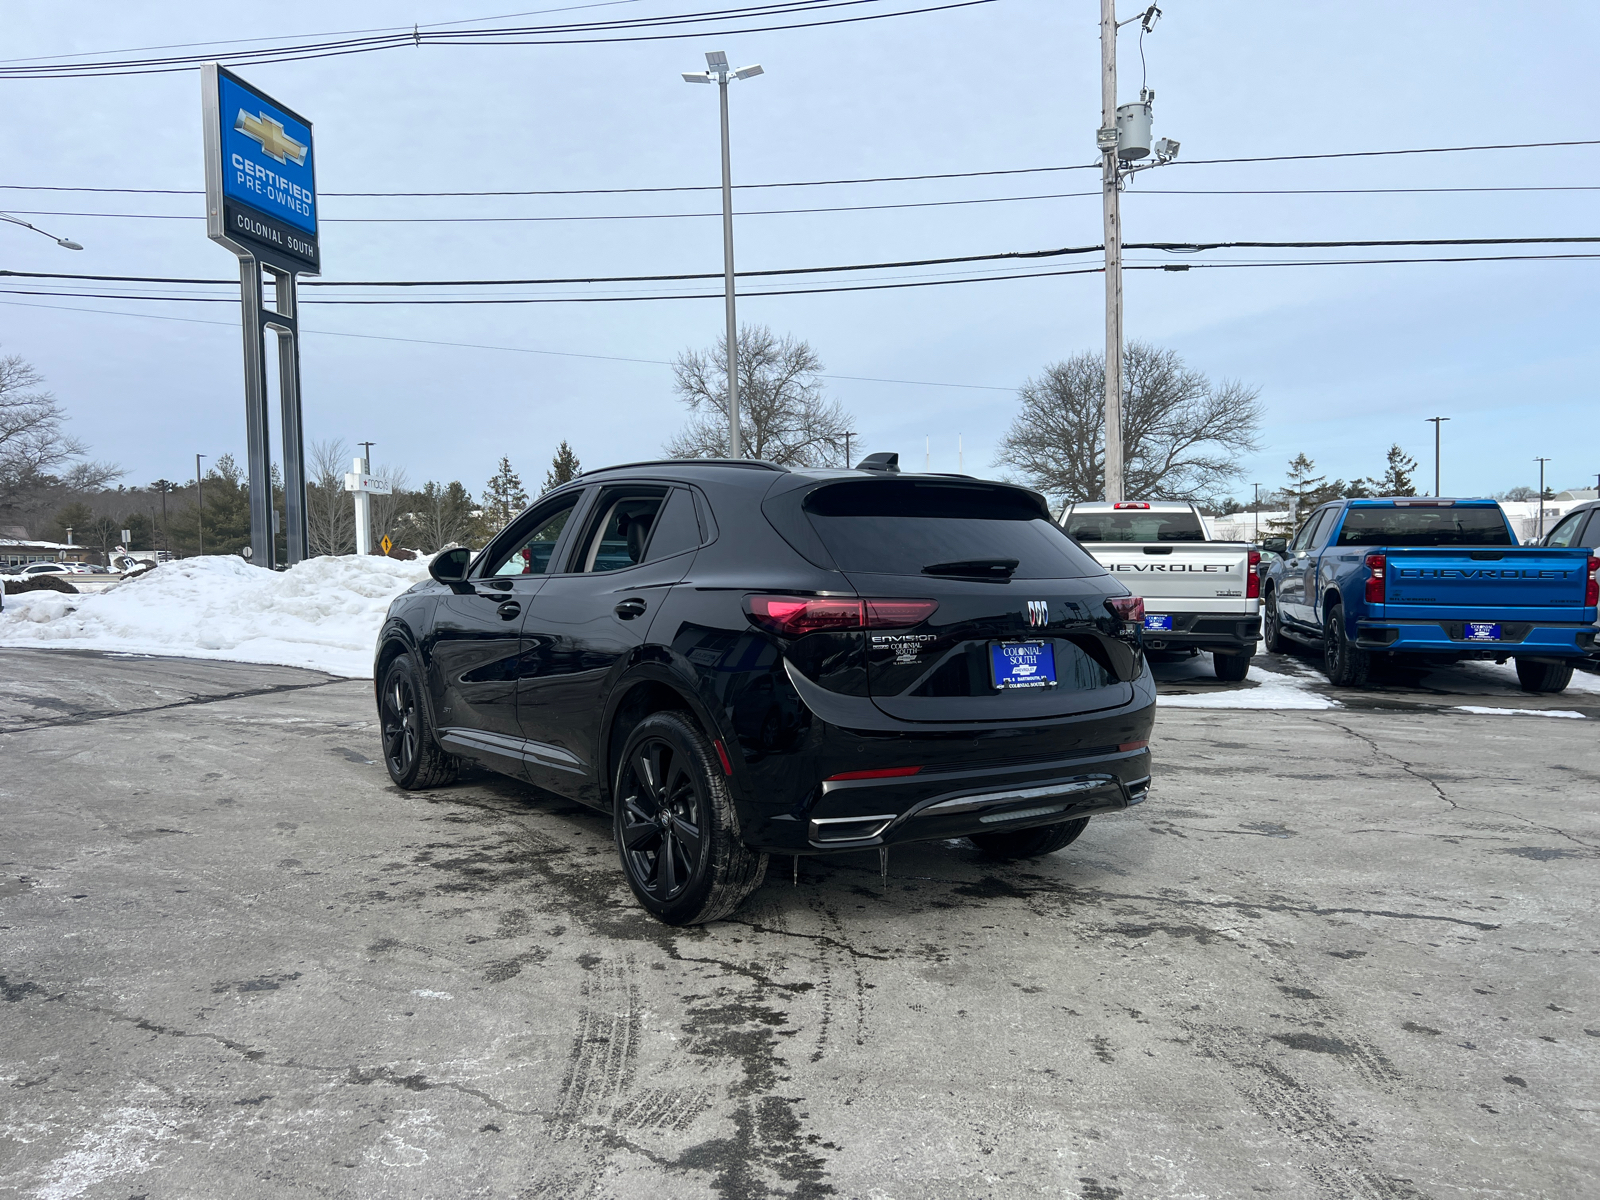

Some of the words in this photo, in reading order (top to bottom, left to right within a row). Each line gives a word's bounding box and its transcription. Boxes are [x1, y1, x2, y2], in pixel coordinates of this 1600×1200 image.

[232, 153, 312, 204] CERTIFIED
[237, 171, 310, 217] PRE-OWNED
[237, 214, 283, 245] COLONIAL
[287, 236, 314, 258] SOUTH
[1103, 564, 1235, 573] HEVROLET
[1400, 569, 1575, 579] CHEVROLET
[871, 634, 937, 643] ENVISION
[890, 642, 923, 650] COLONIAL
[1003, 646, 1042, 657] COLONIAL
[1010, 655, 1037, 665] SOUTH
